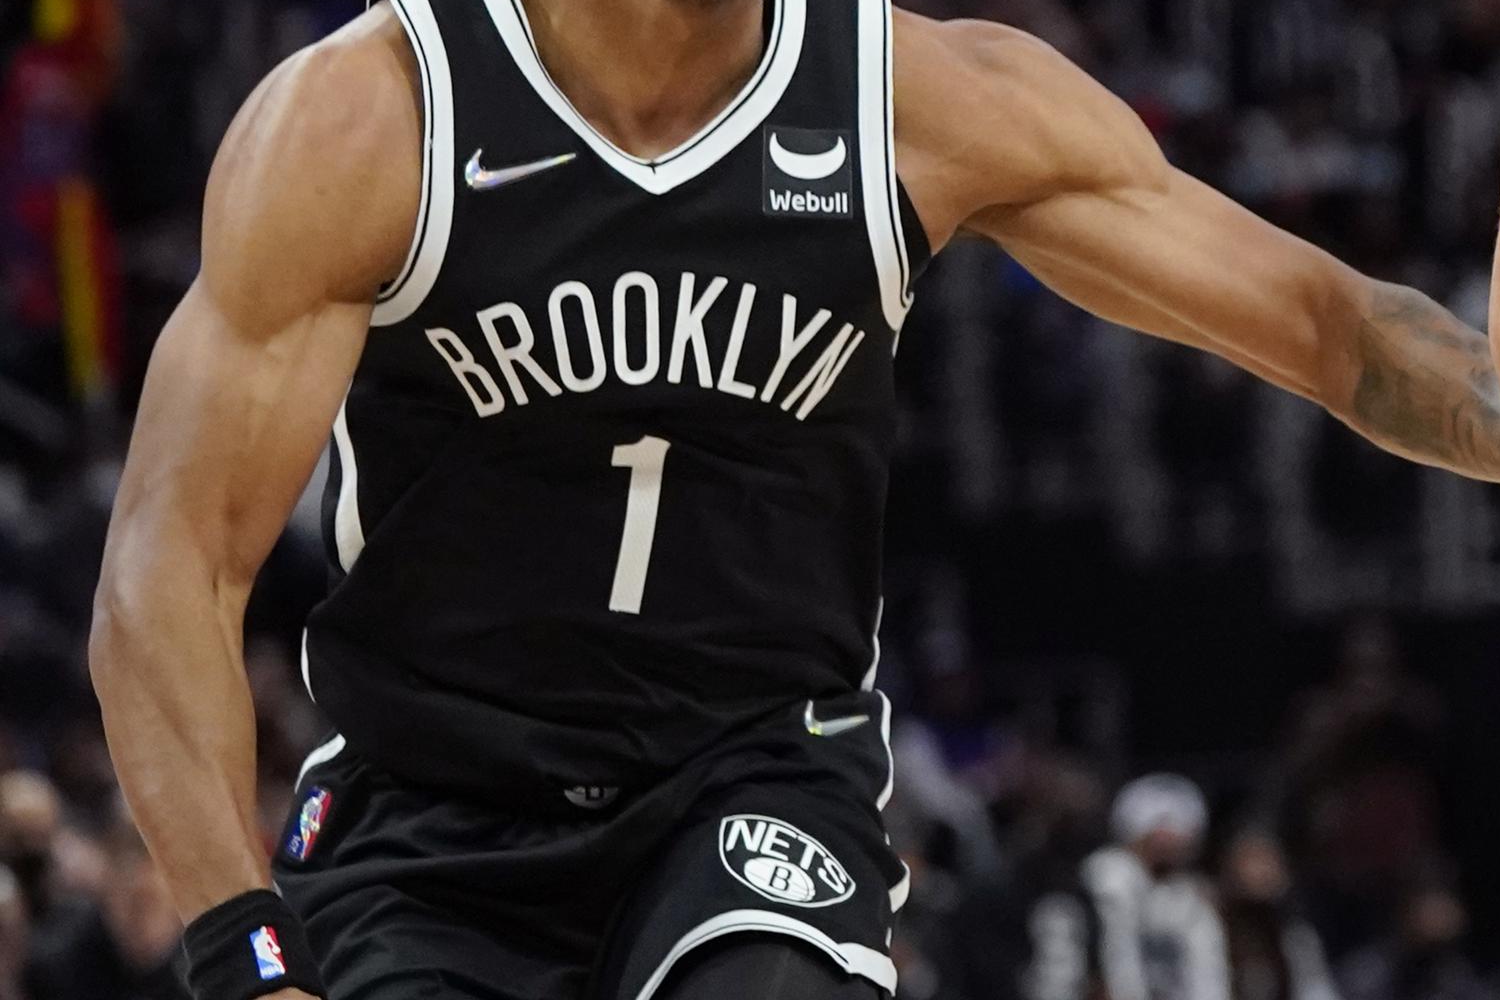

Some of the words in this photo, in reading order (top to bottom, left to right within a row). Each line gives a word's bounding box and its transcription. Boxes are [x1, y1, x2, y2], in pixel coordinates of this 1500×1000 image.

[769, 189, 848, 213] Webull
[425, 271, 865, 421] BROOKLYN
[609, 435, 671, 614] 1
[725, 819, 848, 895] NETS
[769, 866, 792, 891] B
